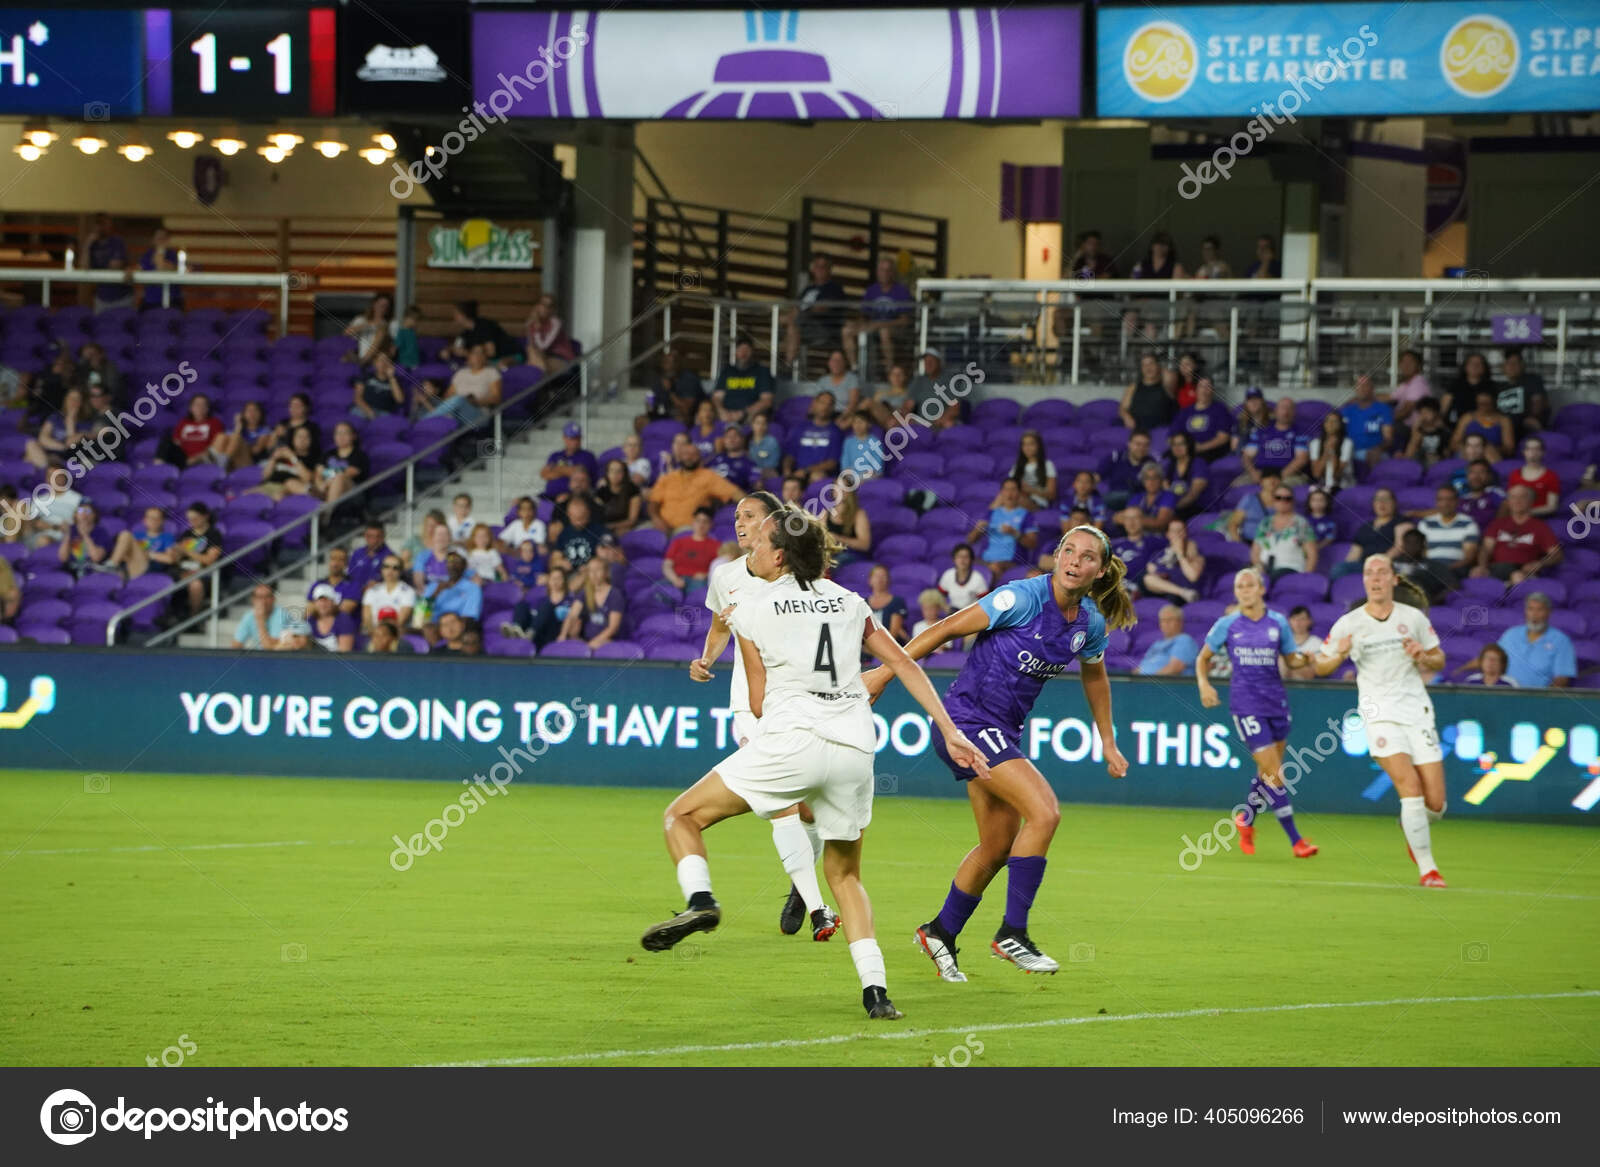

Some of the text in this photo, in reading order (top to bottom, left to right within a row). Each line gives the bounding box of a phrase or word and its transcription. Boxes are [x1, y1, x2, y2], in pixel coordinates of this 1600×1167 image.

[1207, 34, 1321, 57] ST.PETE
[191, 33, 216, 94] 1
[266, 33, 291, 94] 1
[1205, 59, 1408, 84] CLEARWATER
[1503, 318, 1529, 339] 36
[773, 597, 845, 616] MENGES
[814, 622, 838, 687] 4
[179, 692, 333, 737] YOU'RE
[344, 696, 504, 743] GOING
[513, 702, 576, 745] TO
[587, 704, 700, 749] HAVE
[710, 707, 748, 750] T
[1131, 721, 1241, 769] THIS.
[1240, 715, 1262, 736] 15
[977, 727, 1008, 755] 17
